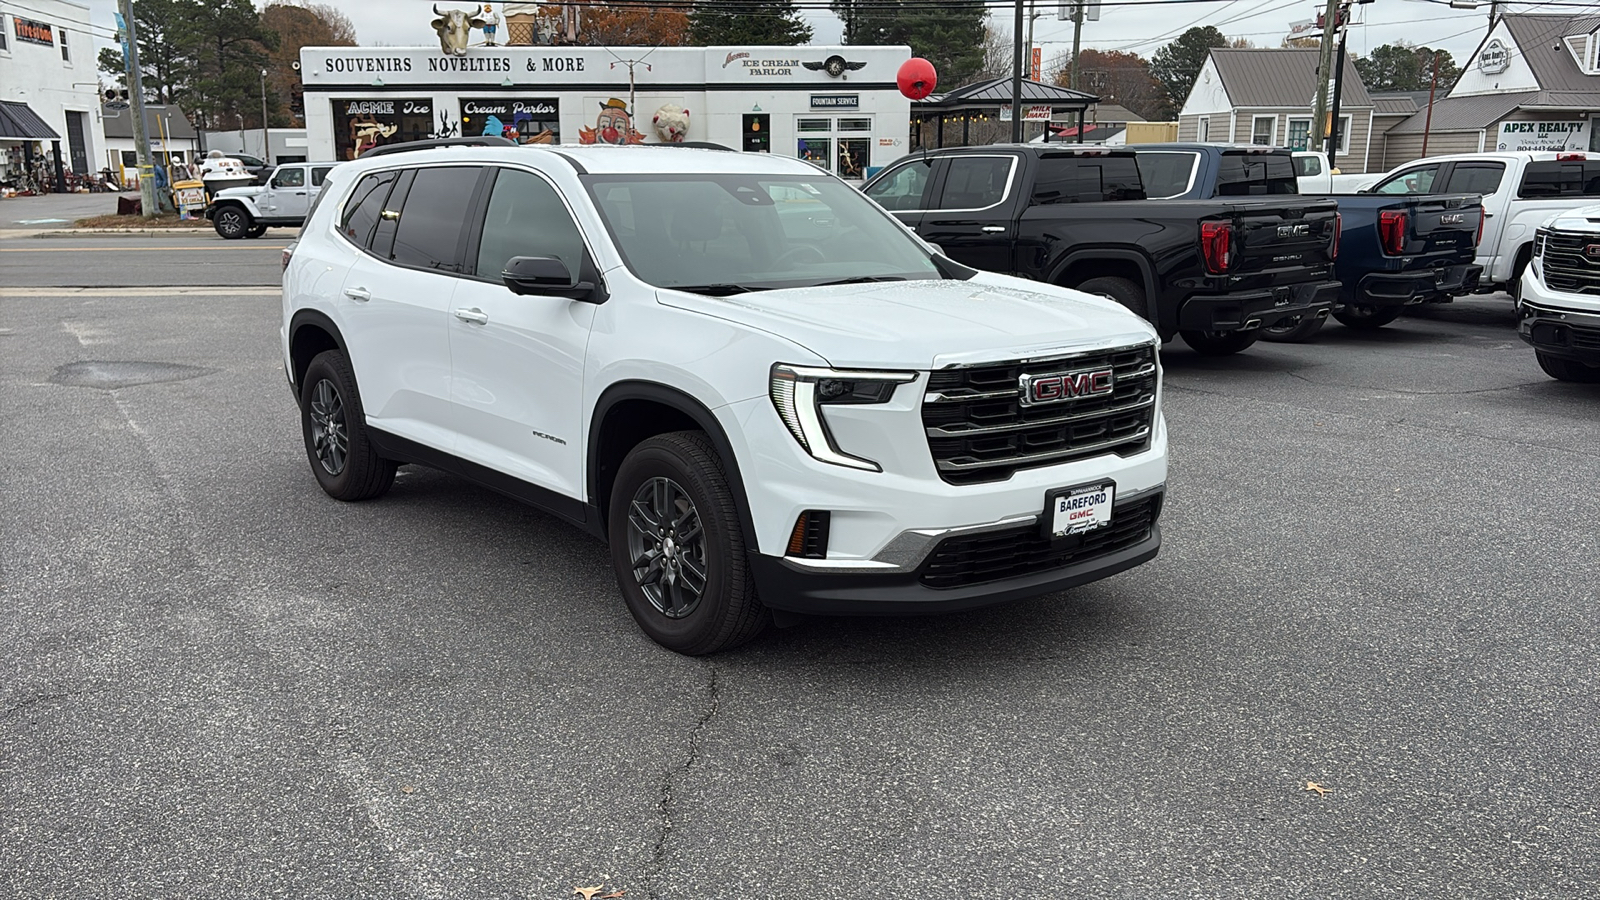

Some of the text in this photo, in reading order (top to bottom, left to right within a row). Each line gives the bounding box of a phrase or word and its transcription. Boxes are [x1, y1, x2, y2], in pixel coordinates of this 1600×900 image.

[14, 18, 53, 42] Firestone
[325, 57, 585, 72] SOUVENIRS NOVELTIES & MORE
[749, 68, 792, 76] PARLOR
[347, 101, 431, 114] ACME Ice
[464, 101, 556, 114] Cream Parlor
[812, 97, 858, 106] FOUNTAIN SERVICE
[1503, 122, 1584, 133] APEX REALTY
[1441, 213, 1464, 224] GMC
[1277, 224, 1309, 238] GMC
[1273, 254, 1303, 262] DENALI
[1033, 369, 1113, 401] GMC
[532, 430, 567, 446] ACADIA
[1060, 492, 1107, 513] BAREFORD
[1069, 508, 1094, 521] GMC
